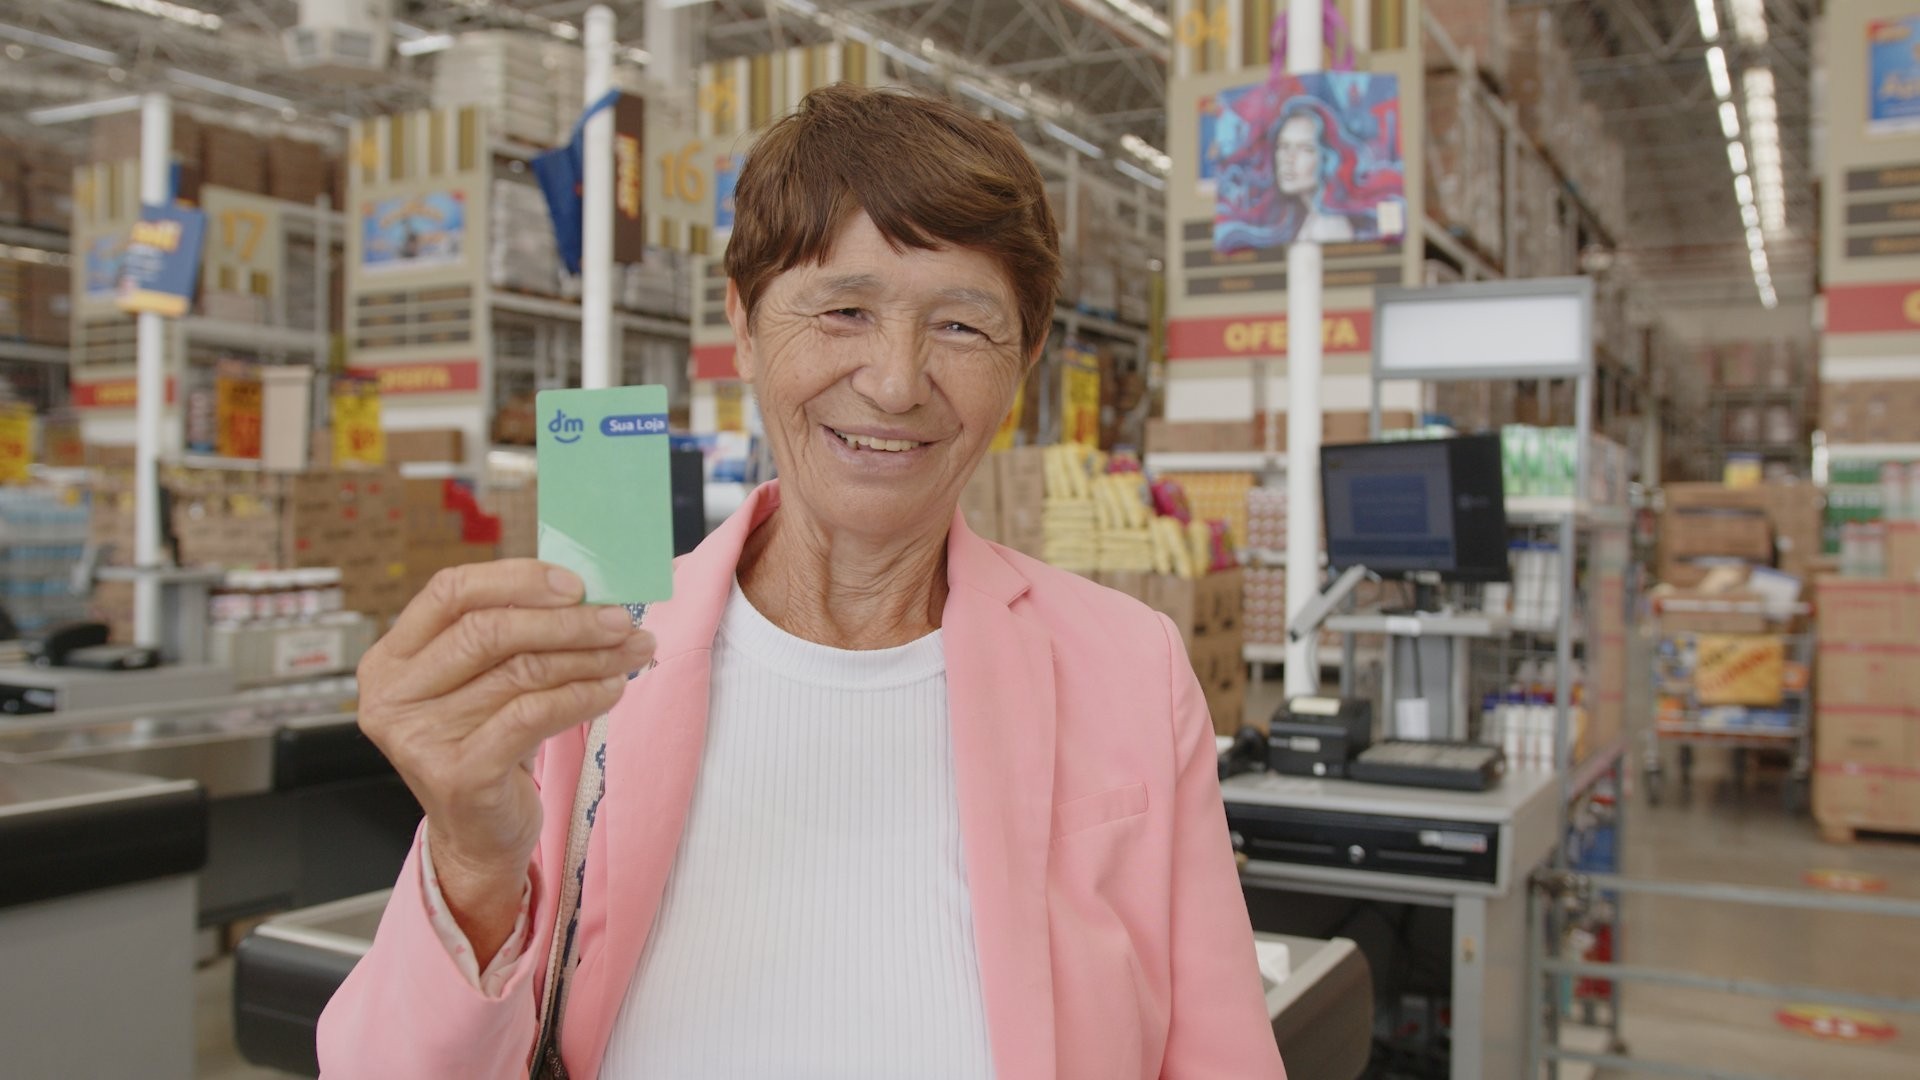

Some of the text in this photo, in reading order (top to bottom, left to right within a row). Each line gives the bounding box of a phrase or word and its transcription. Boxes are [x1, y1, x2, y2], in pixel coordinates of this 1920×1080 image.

[659, 141, 705, 204] 16
[221, 209, 267, 263] 17
[1223, 317, 1359, 352] OFETA
[609, 418, 665, 432] Sua Loja
